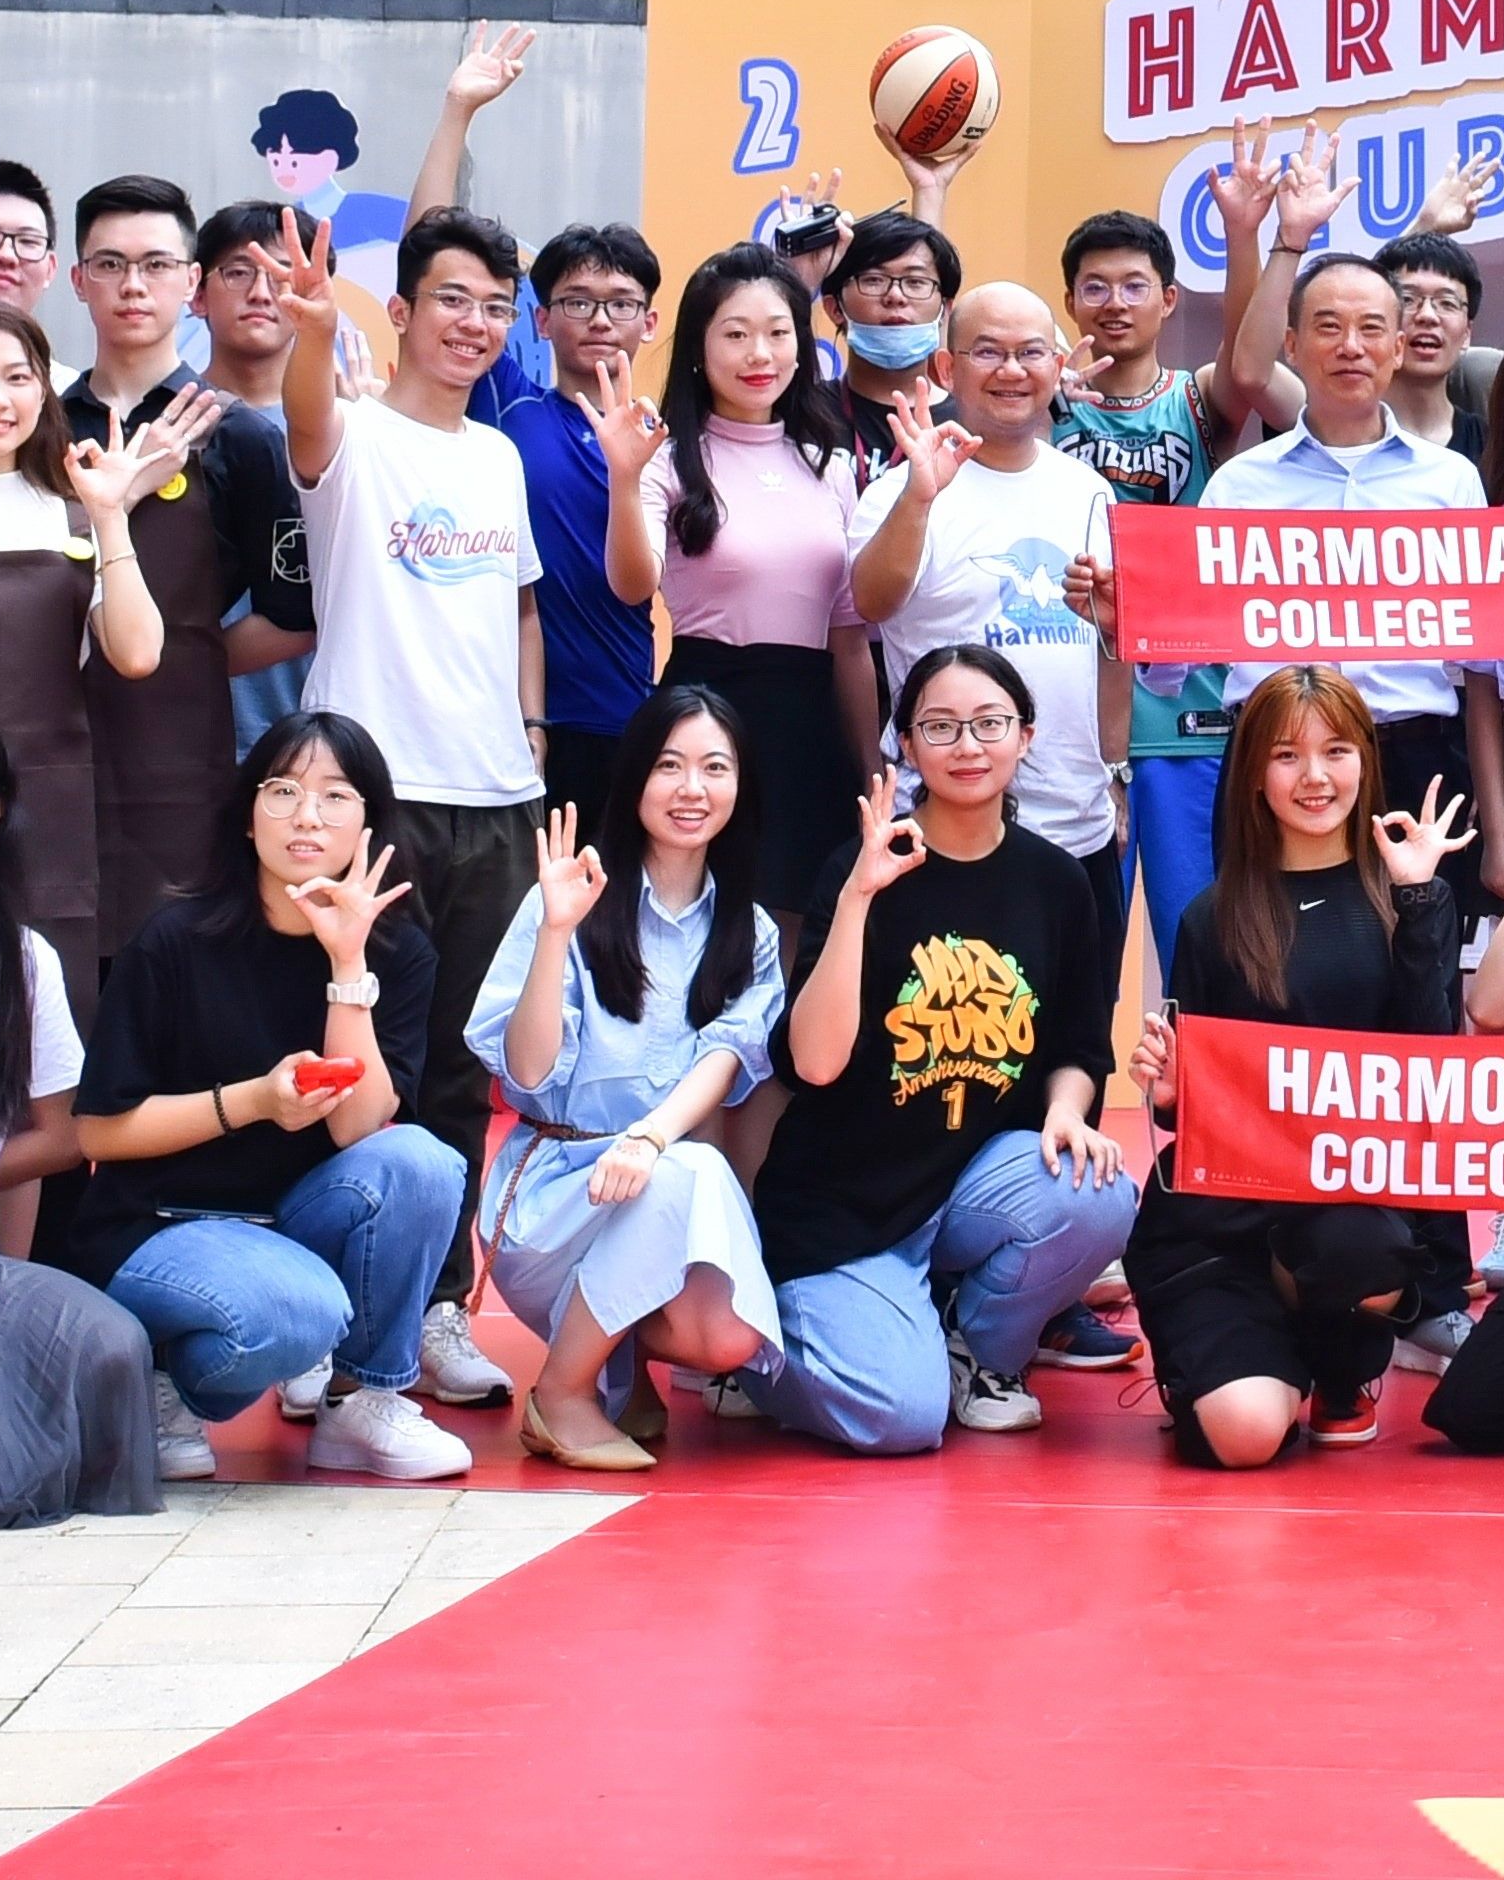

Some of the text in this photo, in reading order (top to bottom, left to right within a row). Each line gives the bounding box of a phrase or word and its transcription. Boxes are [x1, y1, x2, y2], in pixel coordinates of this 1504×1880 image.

[387, 521, 516, 566] Harmonia
[1242, 598, 1475, 649] COLLEGE
[941, 1081, 966, 1130] 1
